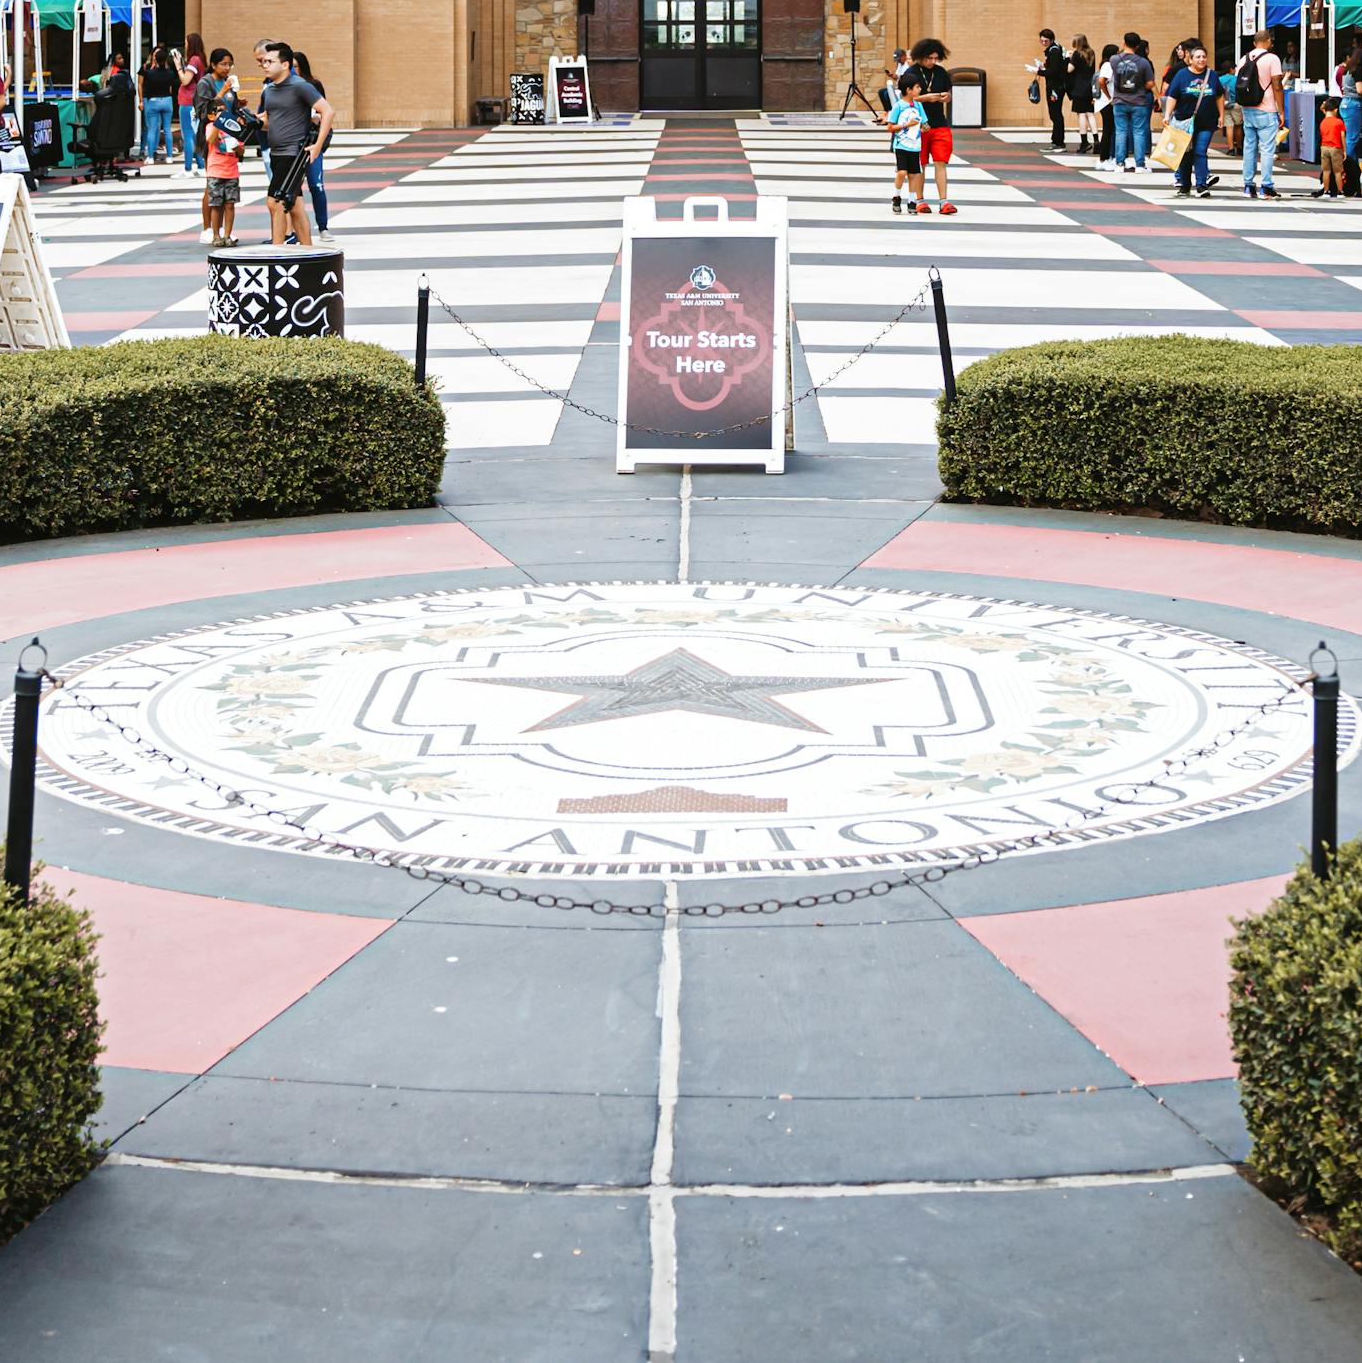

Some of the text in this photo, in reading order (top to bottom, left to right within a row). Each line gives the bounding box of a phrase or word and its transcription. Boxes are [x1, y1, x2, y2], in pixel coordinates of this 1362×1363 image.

[646, 331, 756, 349] Tour Starts
[676, 356, 726, 373] Here
[47, 629, 293, 716] TEXAS
[692, 587, 1308, 717] UNIVERSITY
[187, 783, 1188, 856] SAN ANTONIO
